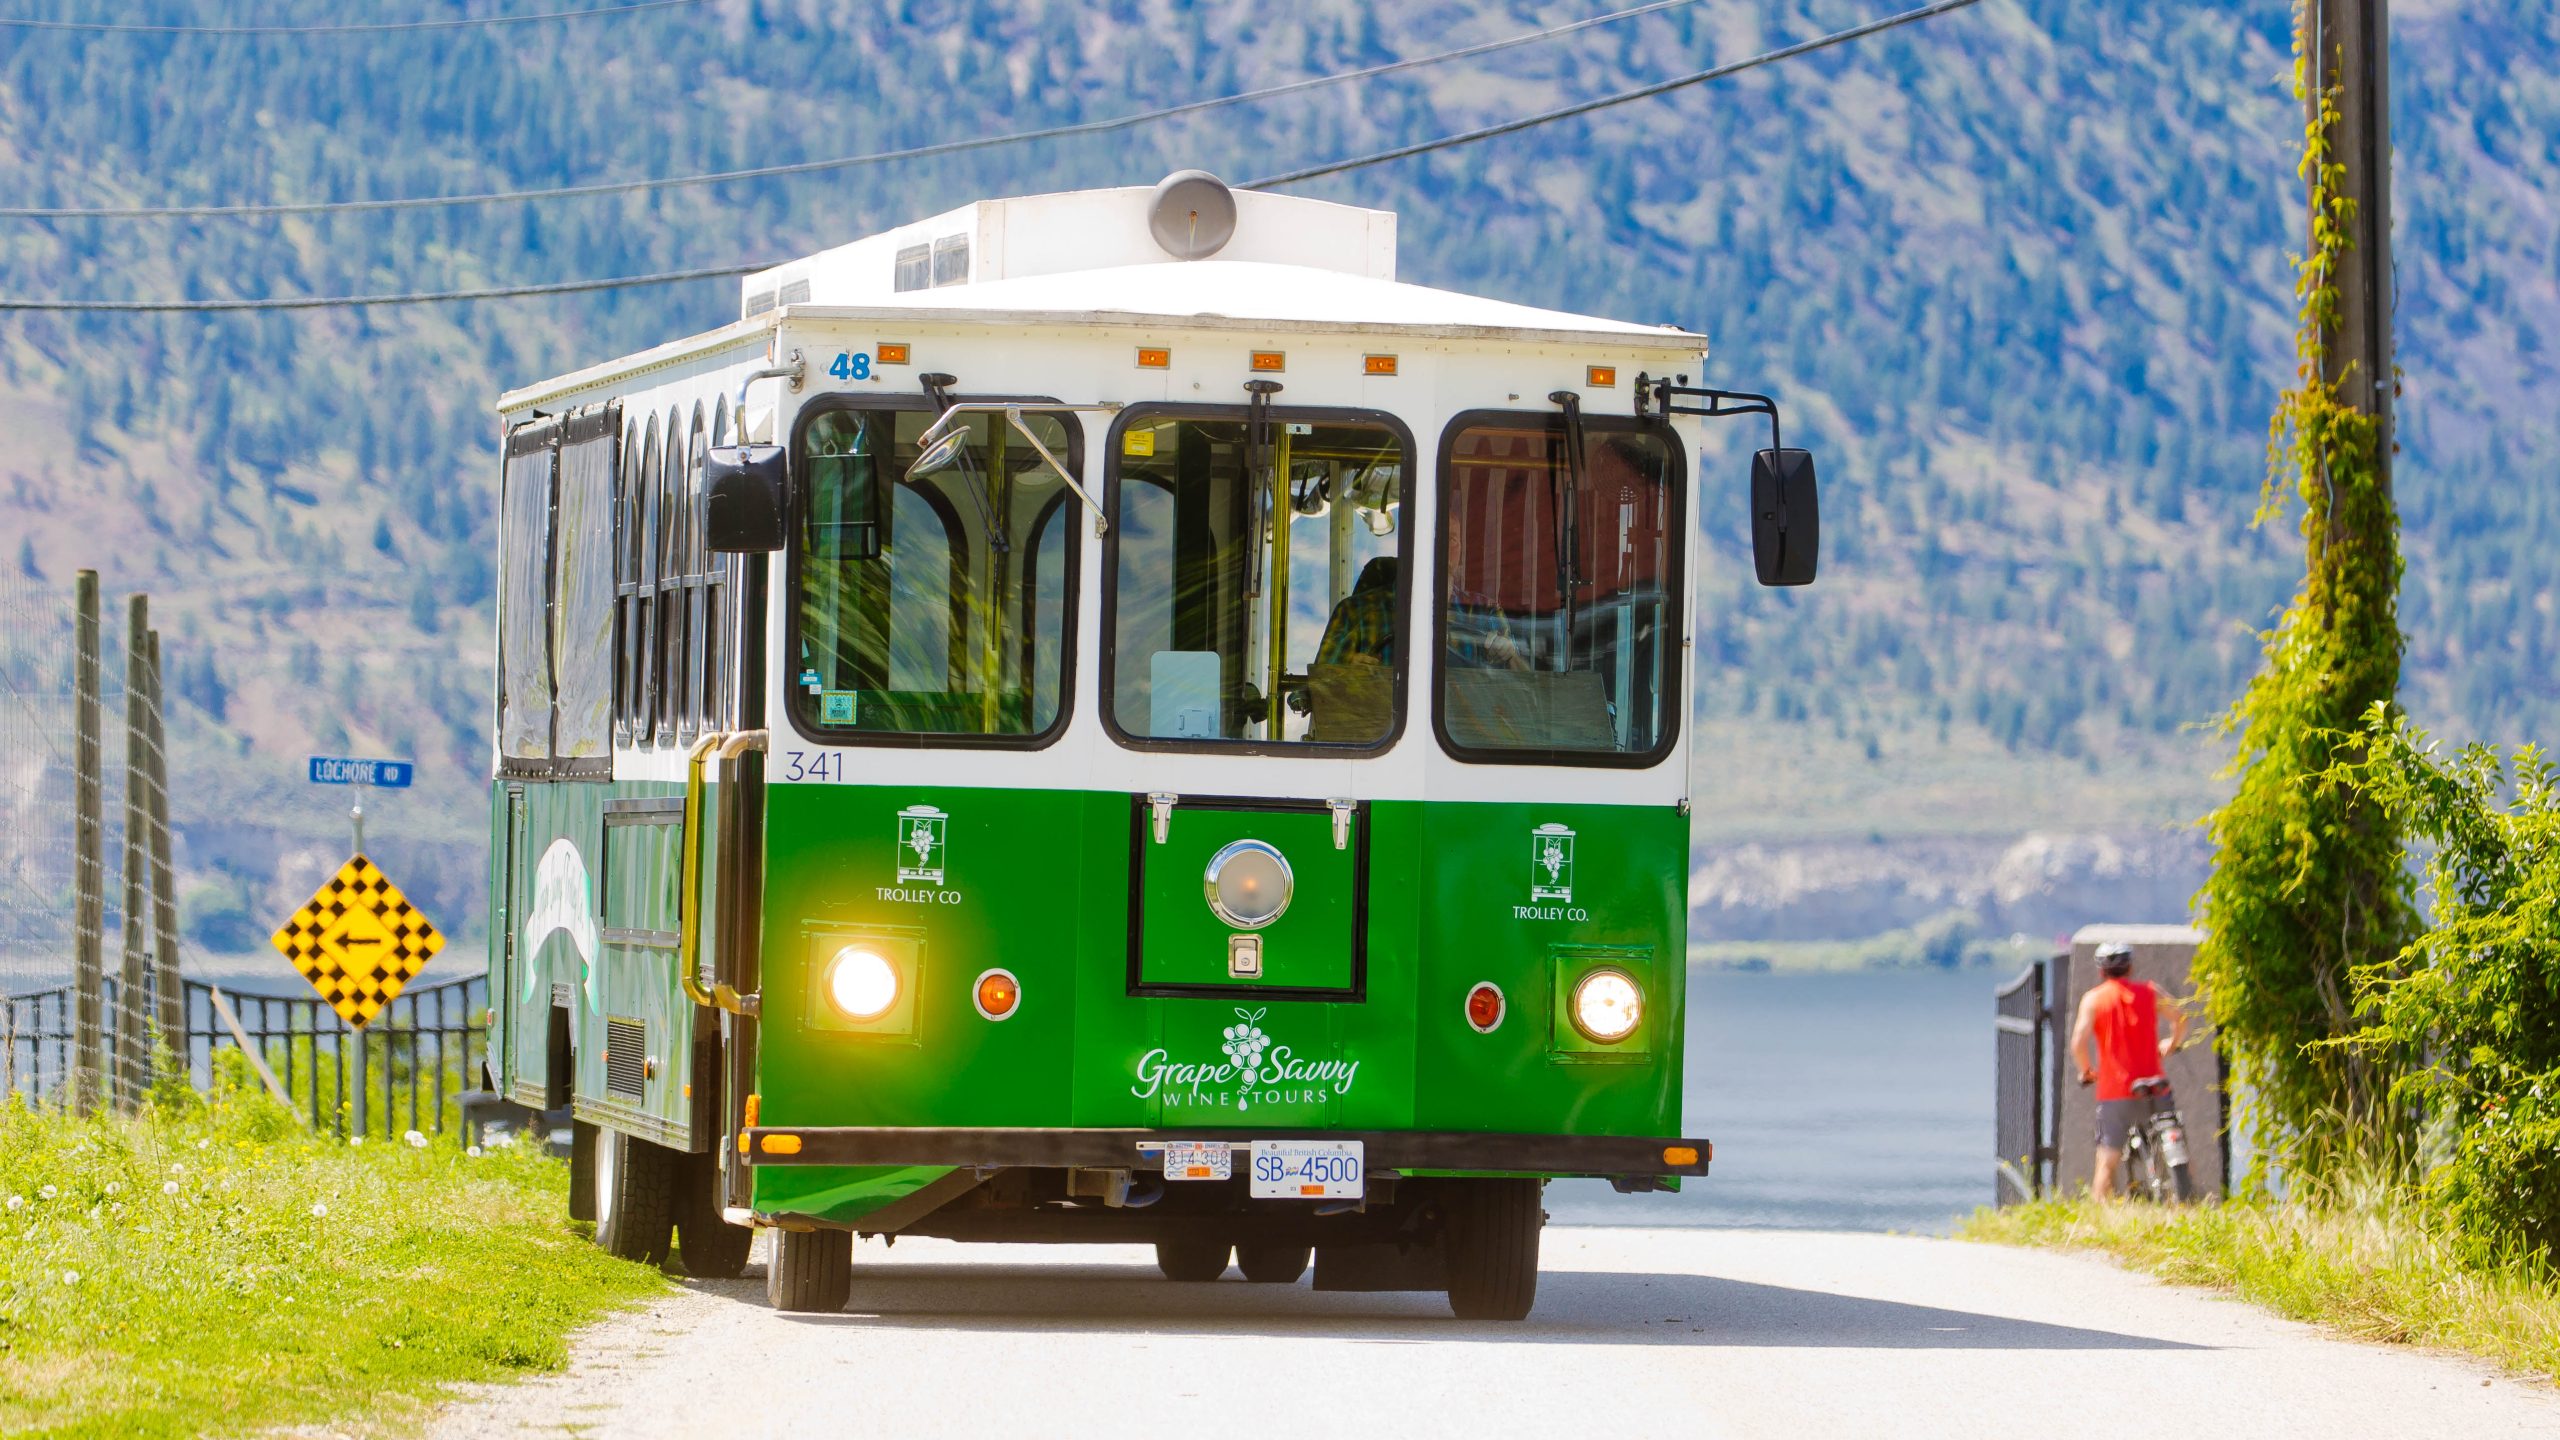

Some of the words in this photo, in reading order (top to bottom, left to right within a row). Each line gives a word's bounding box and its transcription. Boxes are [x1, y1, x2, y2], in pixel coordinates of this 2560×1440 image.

[829, 352, 871, 381] 48
[315, 760, 376, 783] LOCHORE
[785, 751, 843, 783] 341
[875, 887, 936, 904] TROLLEY
[938, 891, 962, 905] CO
[1512, 905, 1565, 920] TROLLEY
[1567, 908, 1590, 922] CO.
[1130, 1048, 1234, 1099] Grape
[1259, 1045, 1360, 1095] Savvy
[1163, 1092, 1229, 1108] WINE
[1252, 1089, 1328, 1105] TOURS
[1261, 1147, 1293, 1157] Beautiful
[1294, 1147, 1317, 1157] British
[1318, 1147, 1353, 1157] Columbia
[1256, 1156, 1284, 1182] SB
[1299, 1156, 1359, 1183] 4500
